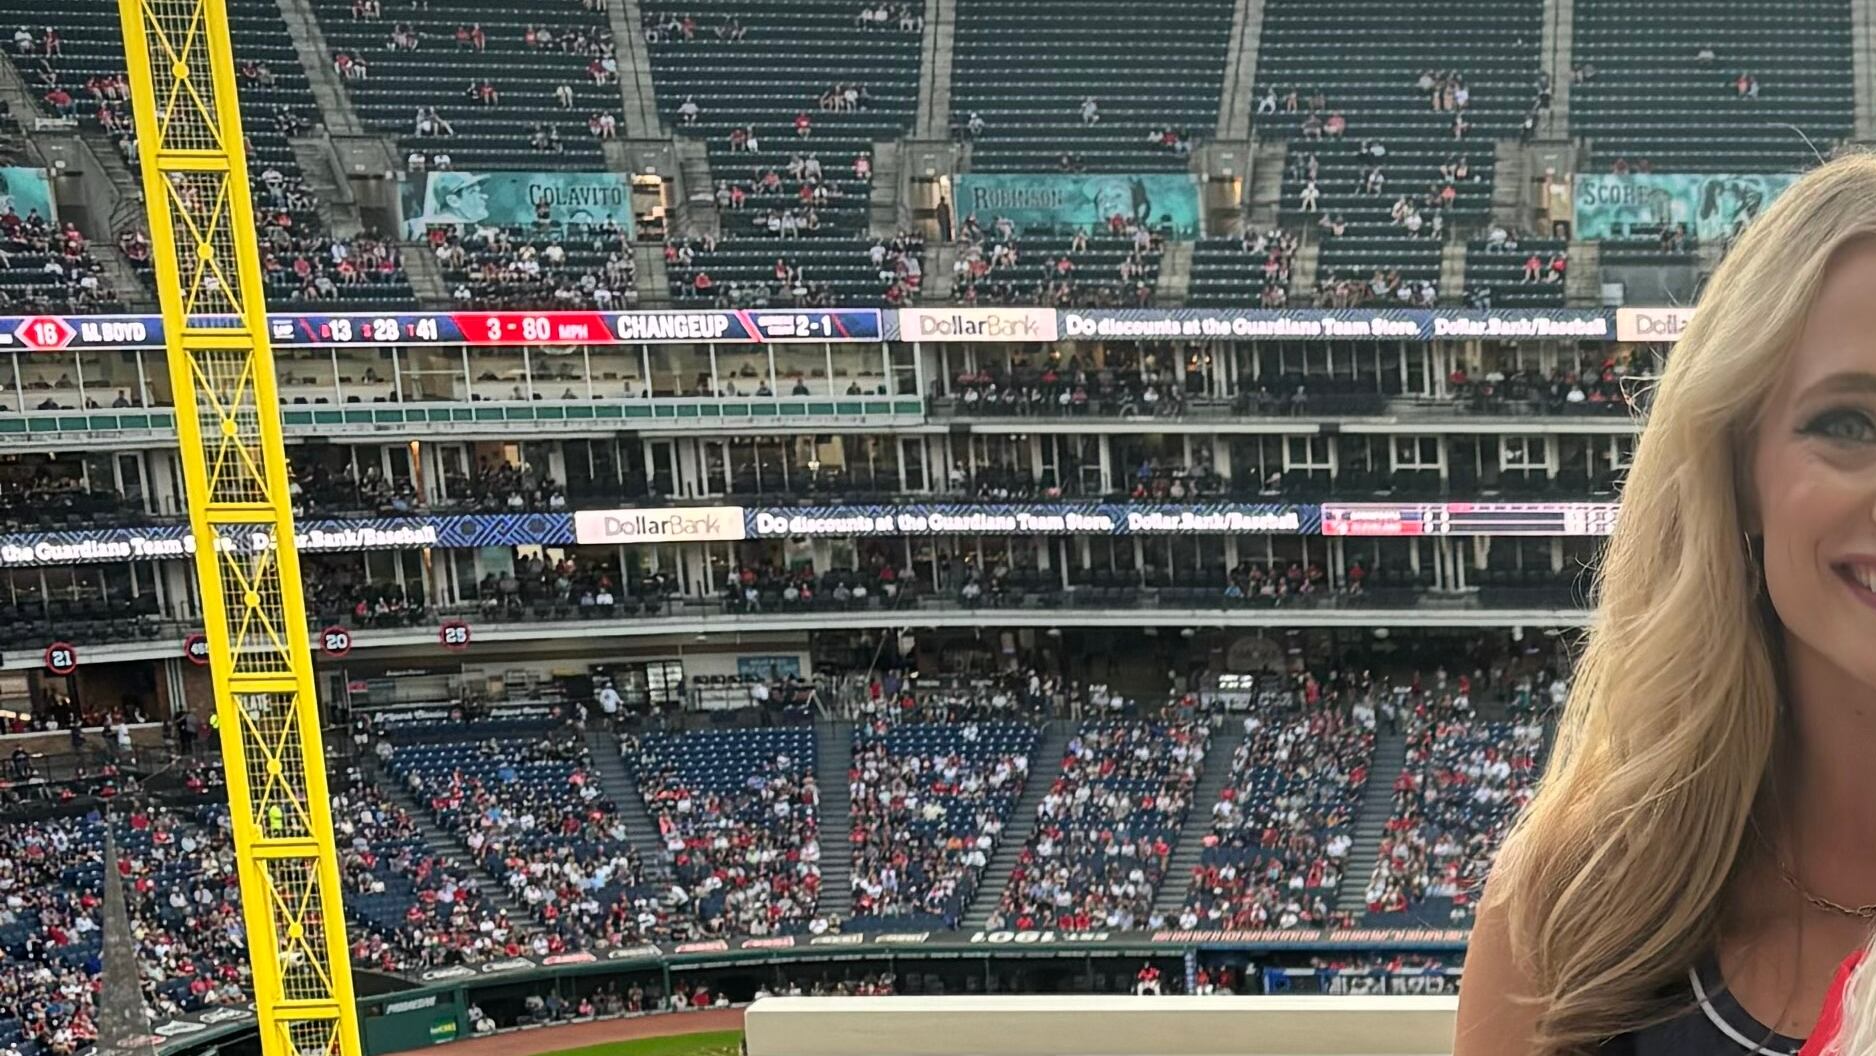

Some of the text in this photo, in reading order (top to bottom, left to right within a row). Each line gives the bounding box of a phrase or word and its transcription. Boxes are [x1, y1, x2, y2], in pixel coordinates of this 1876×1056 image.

[529, 184, 622, 206] COLAVITO
[329, 319, 352, 341] 13
[373, 319, 399, 341] 28
[416, 318, 438, 341] 41
[486, 318, 502, 341] 3
[522, 317, 551, 340] 80
[617, 314, 729, 338] CHANGEUP
[795, 314, 832, 337] 2-1
[920, 314, 1039, 335] DollarBank
[1066, 314, 1096, 335] Do
[1098, 316, 1181, 335] discounts
[1182, 317, 1201, 335] at
[1202, 316, 1231, 335] the
[1232, 317, 1321, 335] Guardians
[1321, 317, 1370, 335] Team
[604, 514, 720, 536] DollarBank
[756, 512, 788, 534] Do
[789, 514, 874, 533] discounts
[875, 514, 894, 532] at
[898, 513, 928, 531] the
[928, 513, 1016, 531] Guardians
[1016, 513, 1064, 531] Team
[2, 544, 34, 561] the
[35, 539, 130, 560] Guardians
[131, 536, 182, 556] Team
[325, 633, 348, 650] 20
[53, 650, 73, 667] 21
